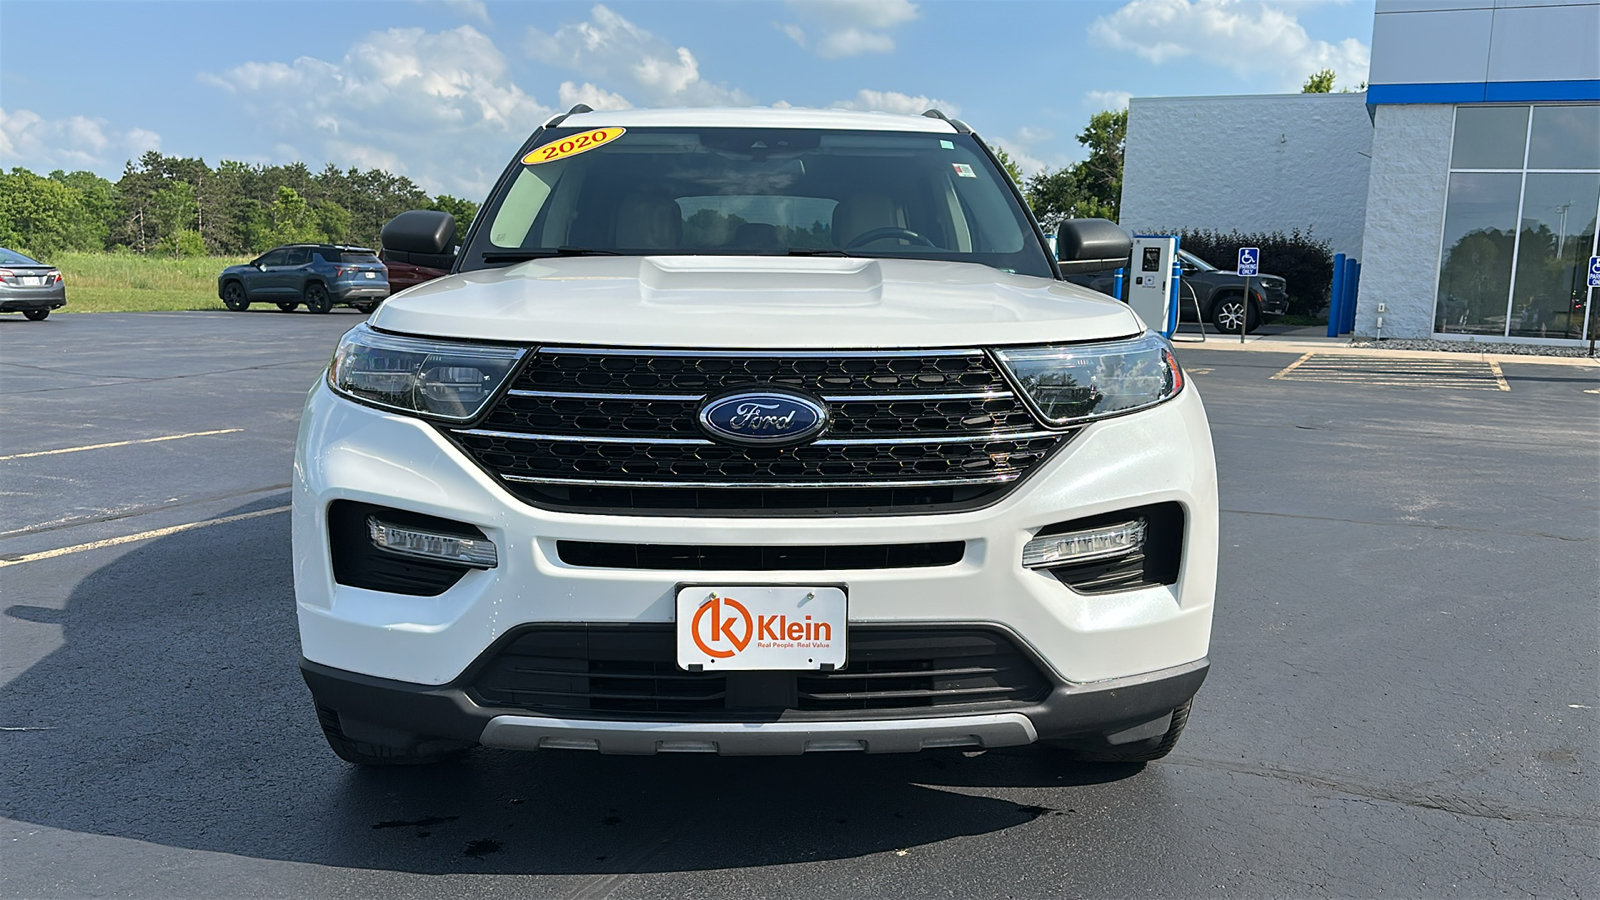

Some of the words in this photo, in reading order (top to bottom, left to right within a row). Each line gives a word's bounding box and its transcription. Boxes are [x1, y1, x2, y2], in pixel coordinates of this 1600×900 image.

[542, 131, 607, 160] 2020
[729, 402, 796, 430] Ford
[757, 615, 832, 641] Klein
